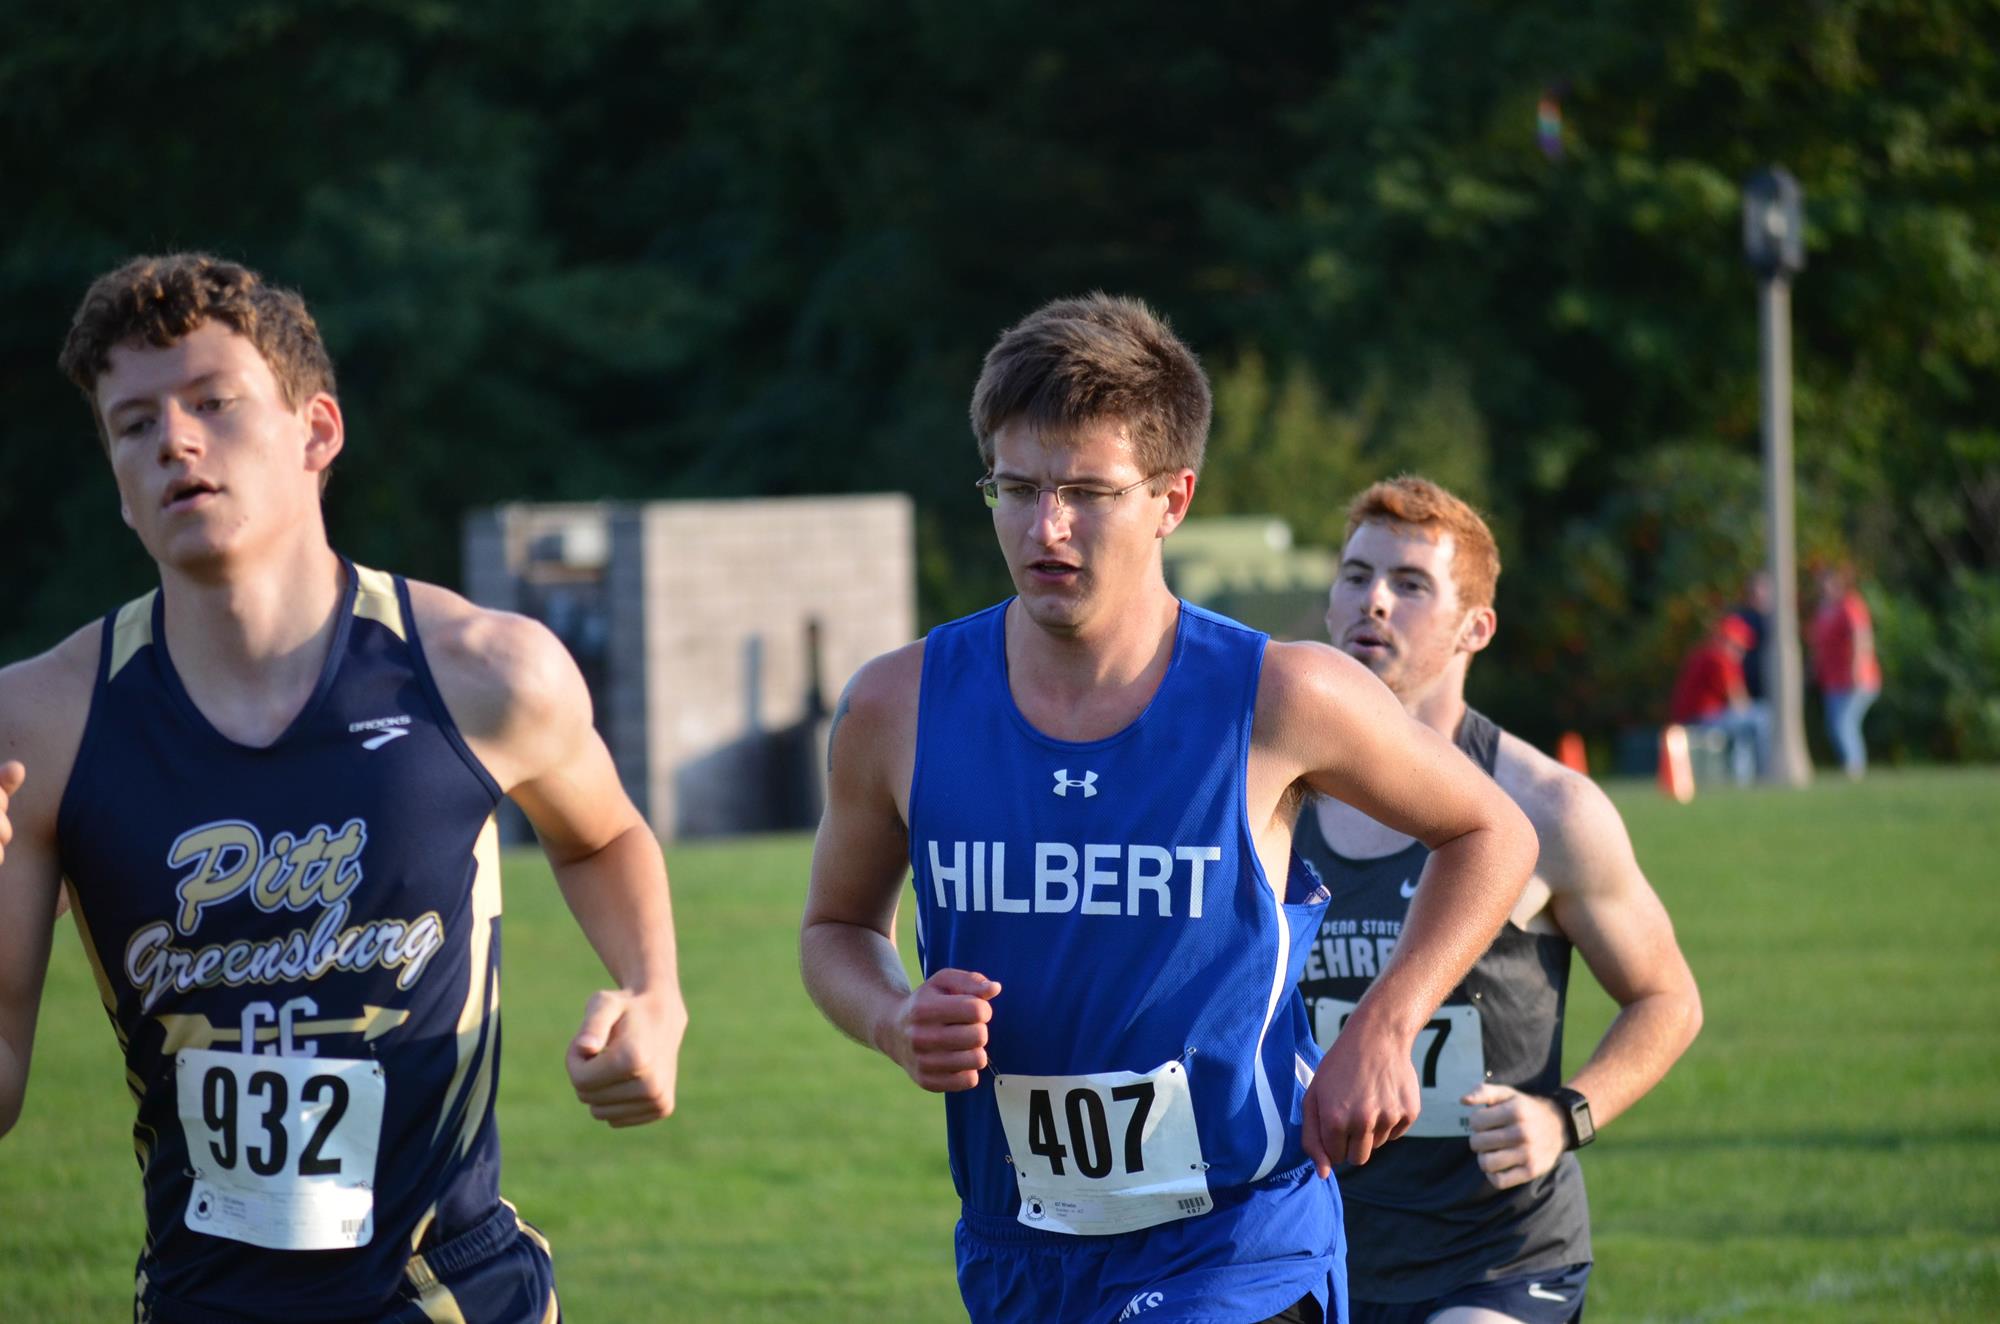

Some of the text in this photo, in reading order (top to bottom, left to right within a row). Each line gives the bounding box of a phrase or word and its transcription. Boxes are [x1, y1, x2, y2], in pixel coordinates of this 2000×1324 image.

[348, 714, 412, 734] BROOKS
[167, 817, 367, 936] Pitt
[928, 840, 1221, 918] HILBERT
[125, 901, 444, 1014] Greensburg
[1322, 920, 1401, 937] PENN STATE
[202, 1066, 349, 1176] 932
[1028, 1082, 1155, 1179] 407
